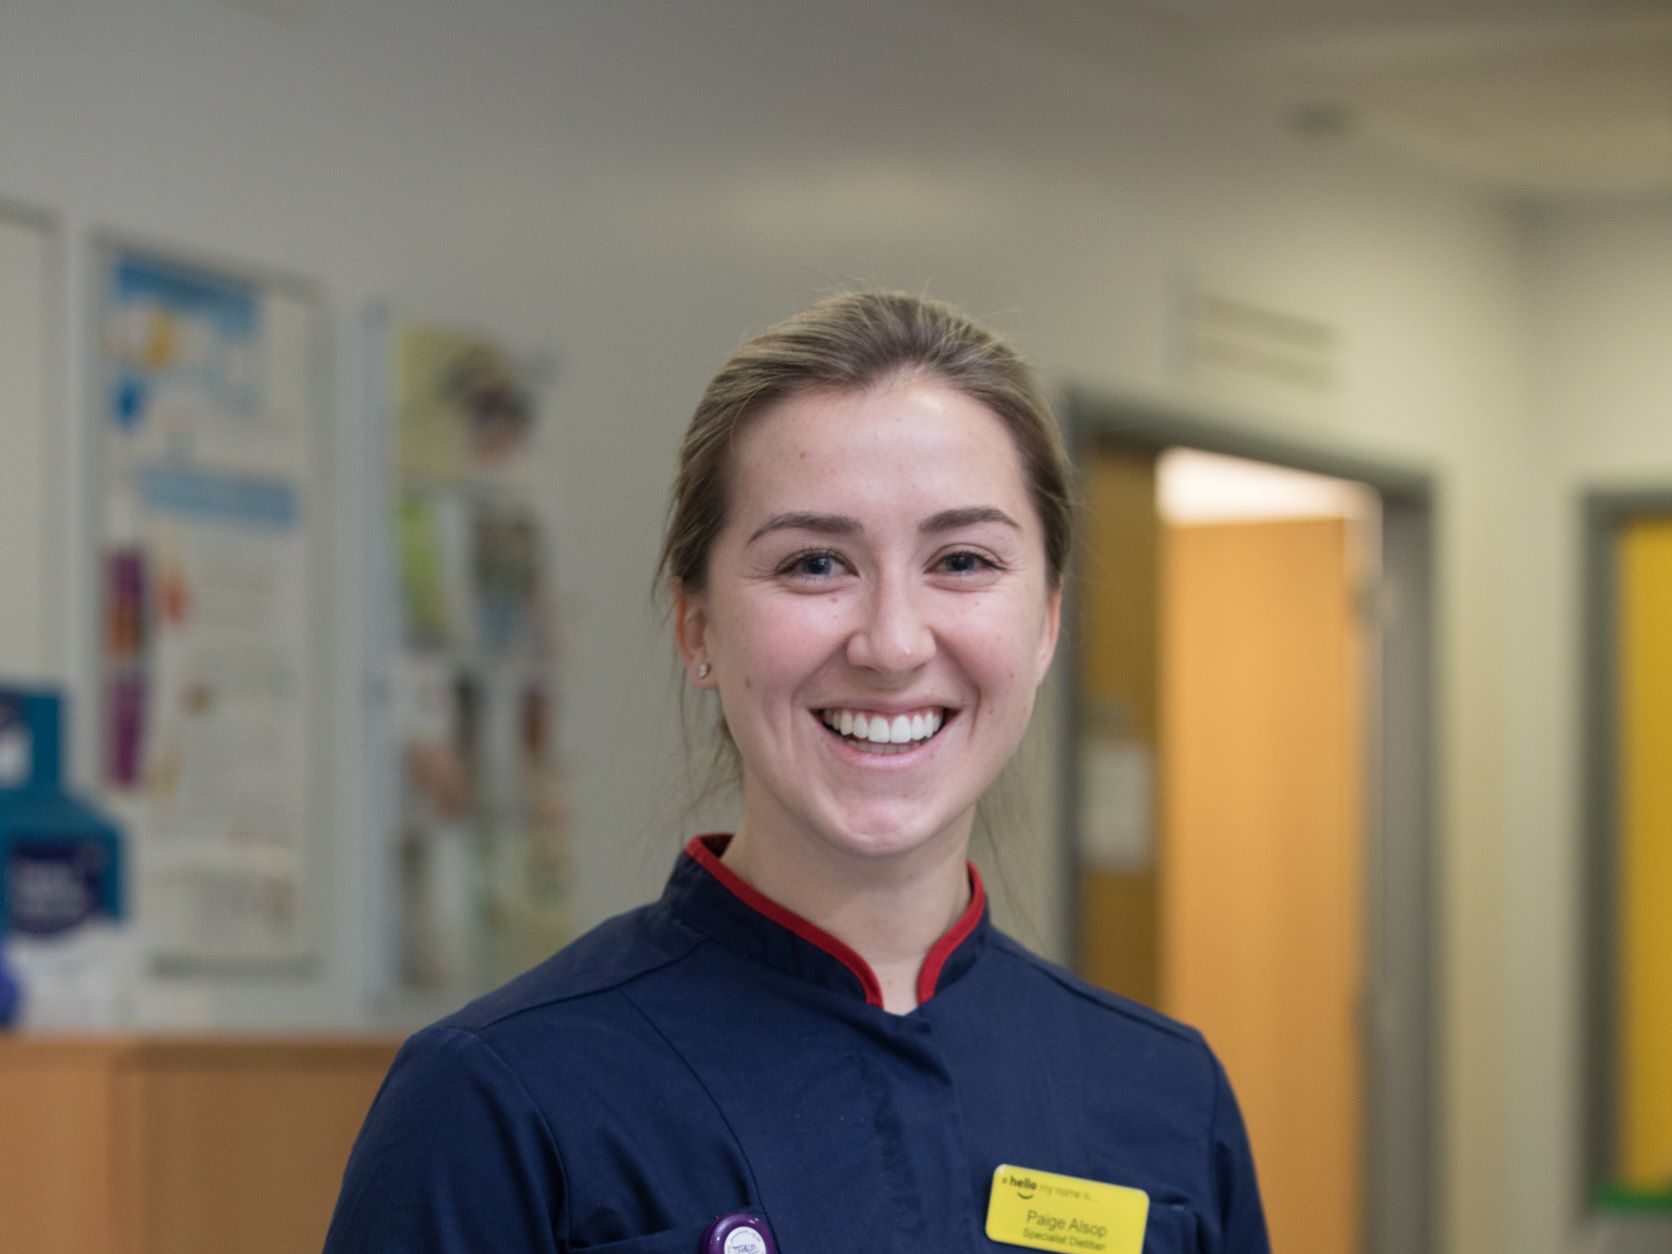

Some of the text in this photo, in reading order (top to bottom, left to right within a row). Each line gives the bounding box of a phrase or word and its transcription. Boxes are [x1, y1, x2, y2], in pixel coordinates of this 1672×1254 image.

[1039, 1183, 1053, 1197] my
[1055, 1186, 1081, 1200] name
[1026, 1209, 1108, 1239] Paige Alsop
[1023, 1227, 1067, 1244] Specialist
